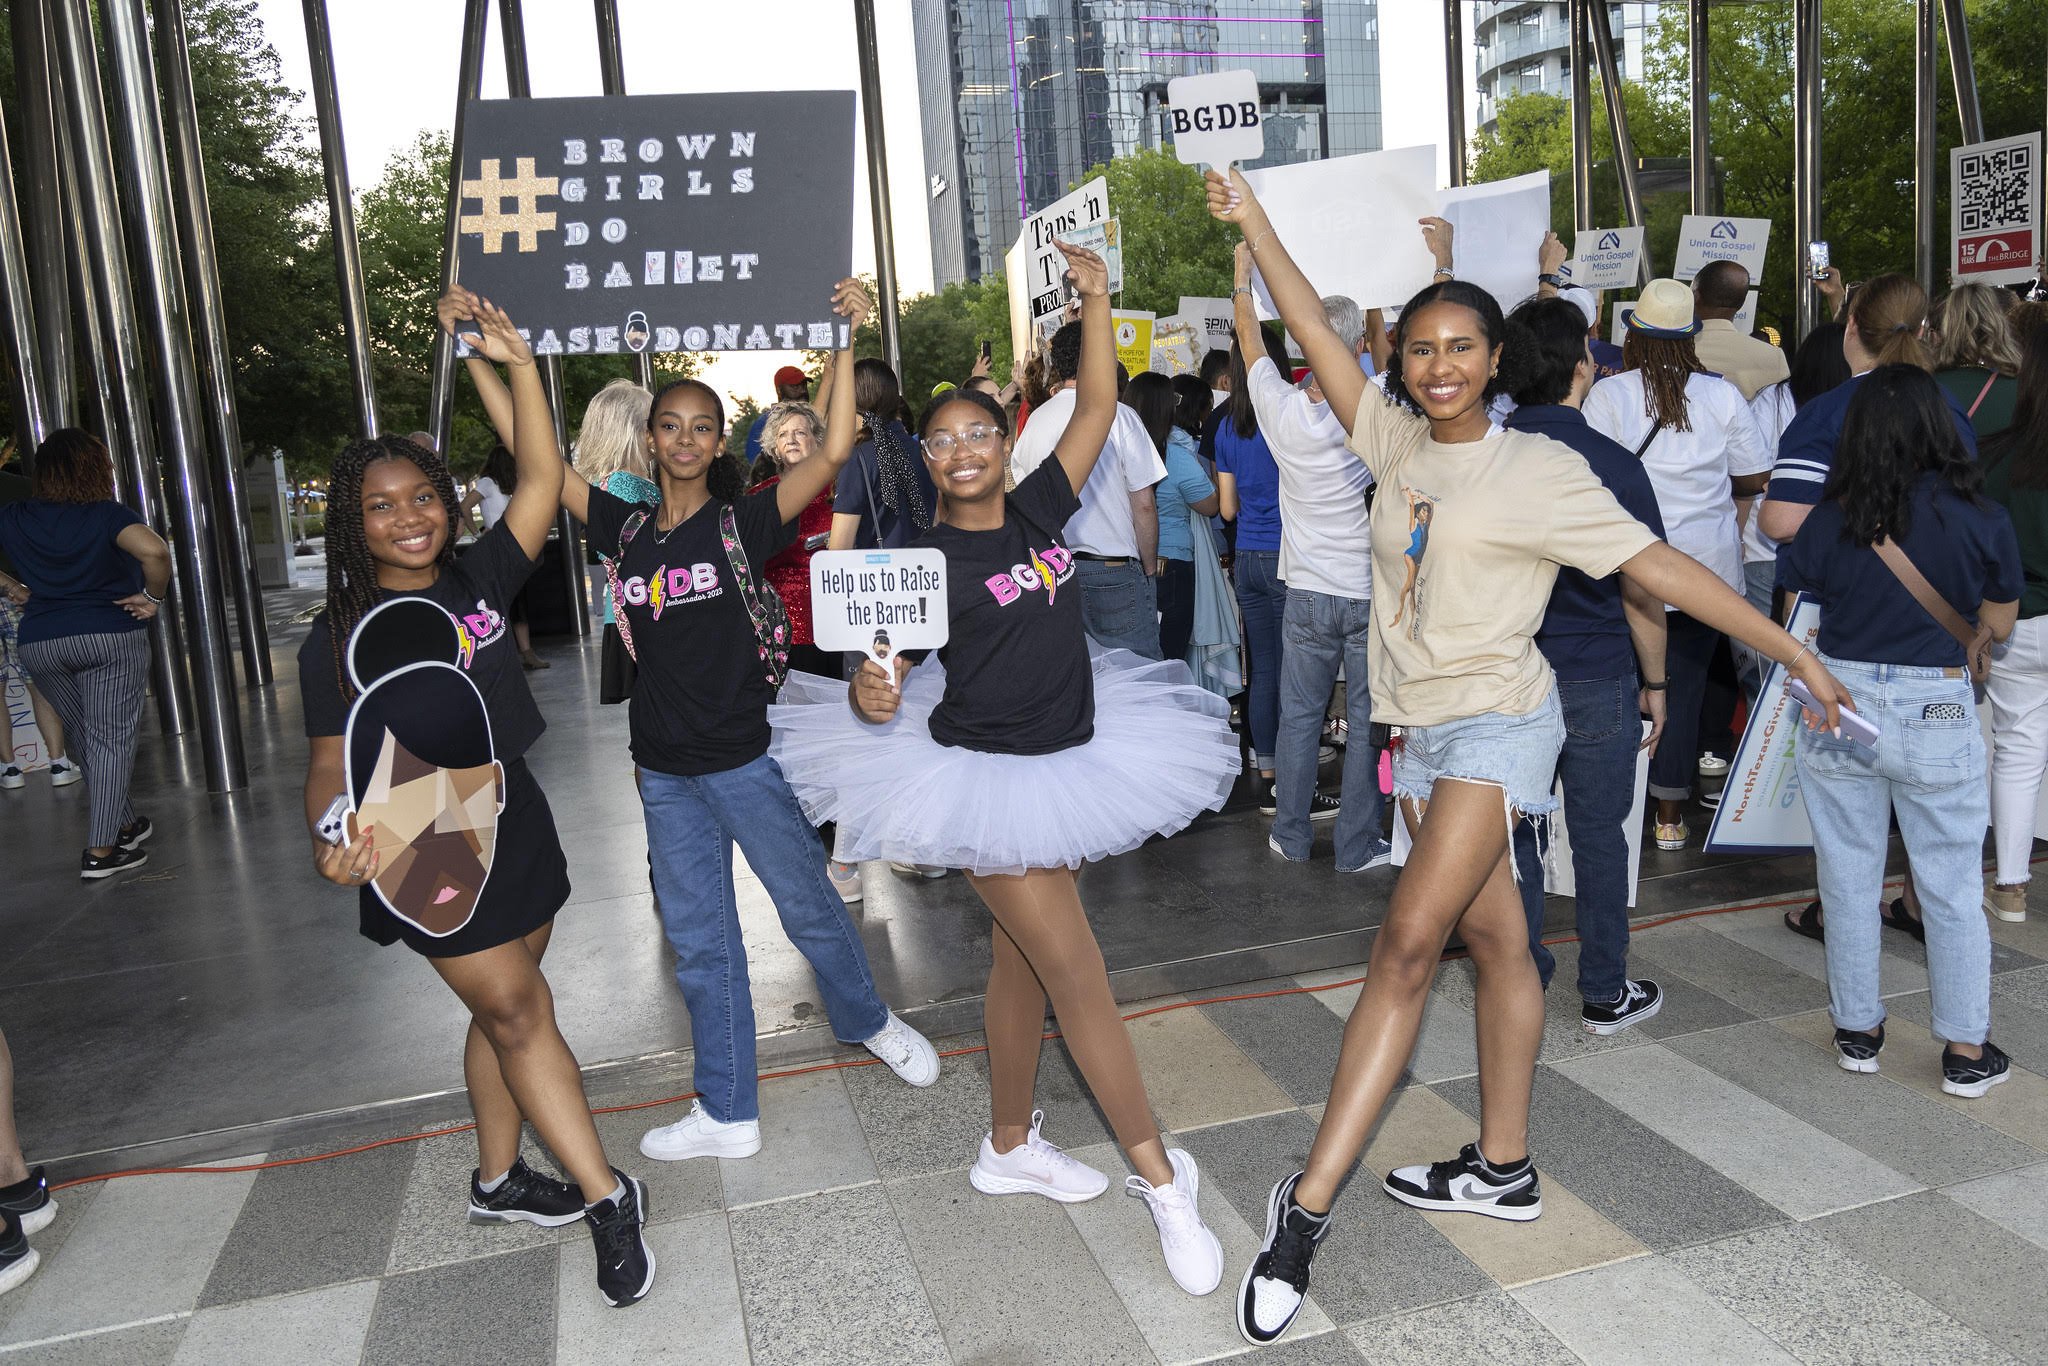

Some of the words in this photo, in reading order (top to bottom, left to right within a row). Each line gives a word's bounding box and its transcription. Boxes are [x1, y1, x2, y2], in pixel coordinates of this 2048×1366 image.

[1171, 101, 1259, 134] BGDB
[563, 131, 756, 165] BROWN
[560, 167, 755, 203] GIRLS
[564, 217, 628, 247] DO
[1689, 240, 1717, 249] Union
[1720, 240, 1756, 252] Gospel
[1580, 253, 1604, 262] Union
[1606, 250, 1634, 261] Gospel
[1702, 250, 1738, 260] Mission
[1961, 243, 1975, 256] 15
[1999, 250, 2029, 261] BRIDGE
[564, 250, 759, 289] BAET
[1592, 261, 1622, 271] Mission
[456, 325, 620, 358] PASE
[654, 321, 850, 353] DONATE!
[822, 568, 854, 599] Help
[859, 572, 876, 593] us
[880, 568, 895, 592] to
[900, 564, 940, 592] Raise
[665, 593, 706, 608] Ambassador
[706, 587, 723, 599] 2023
[846, 600, 872, 626] the
[876, 597, 927, 625] Barre!
